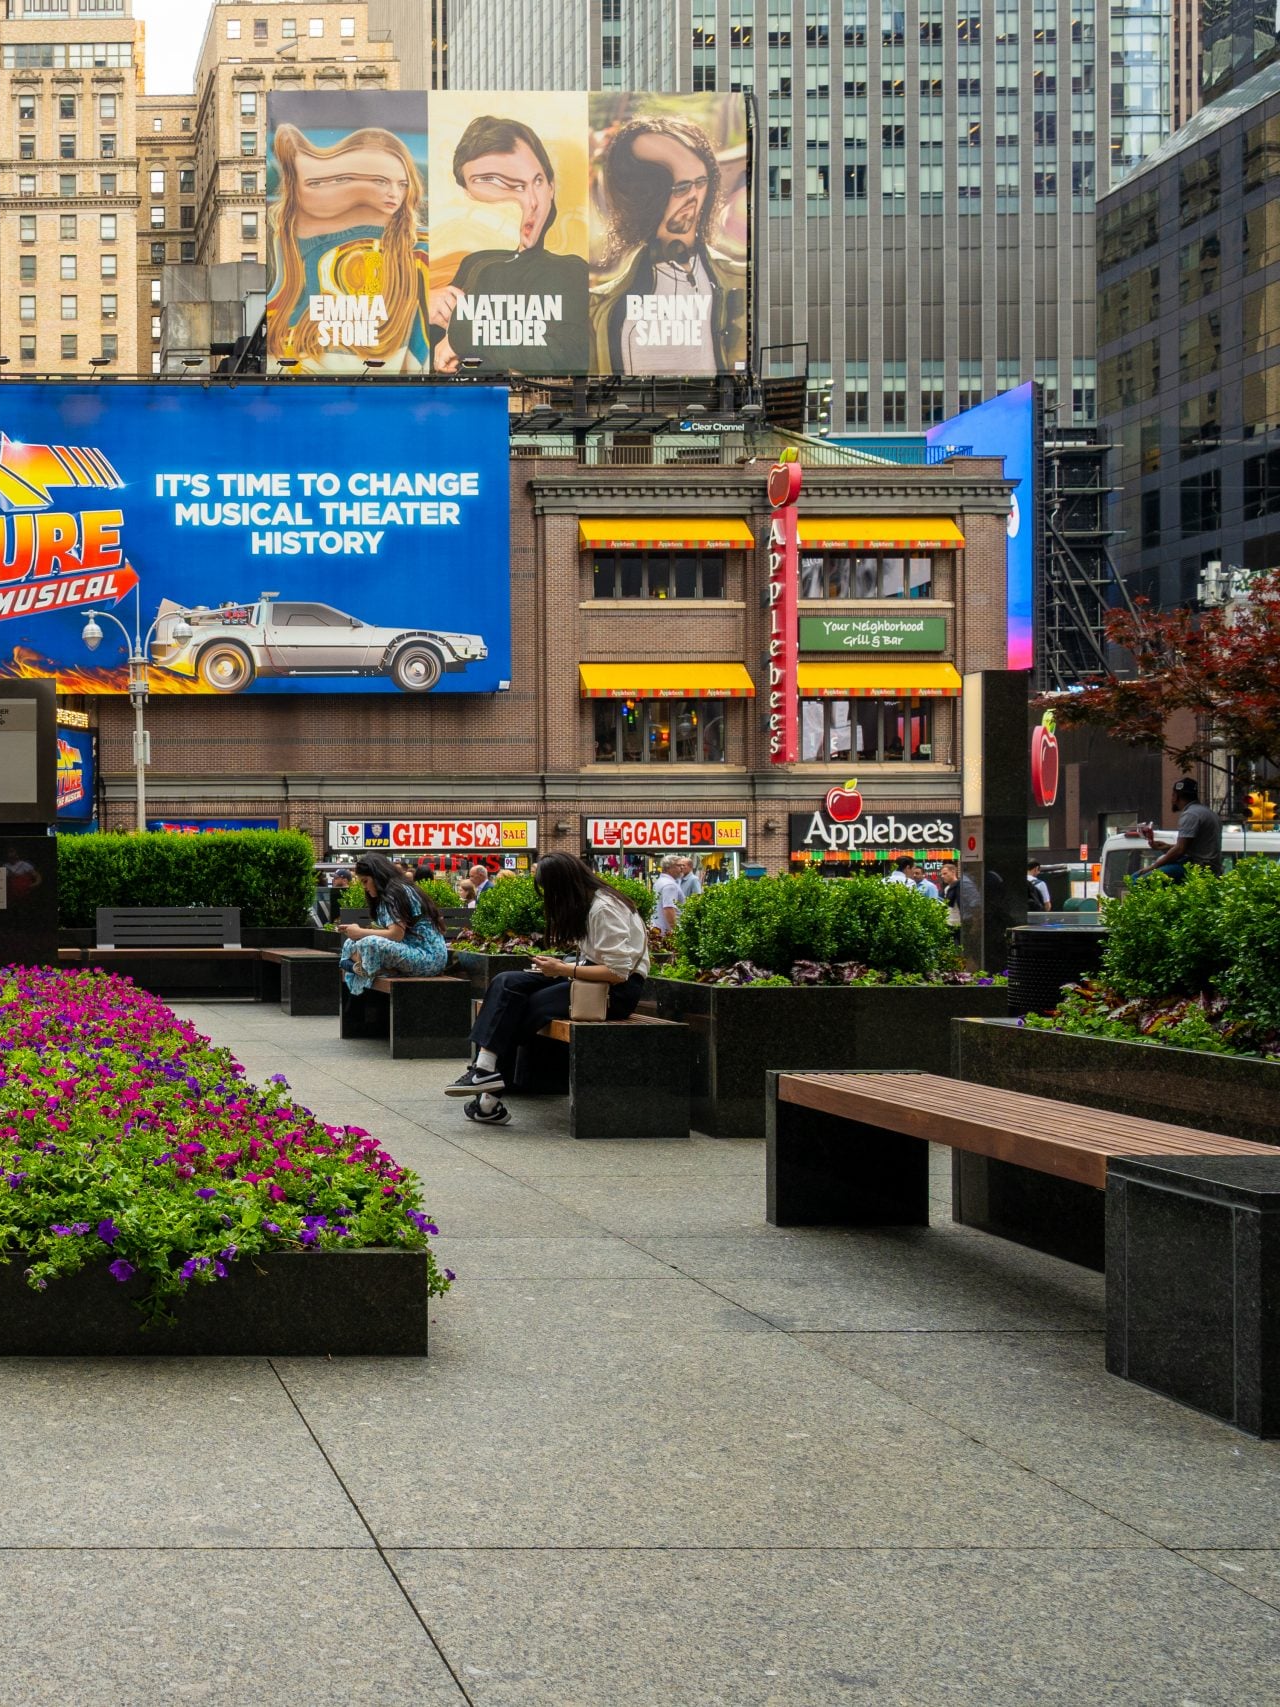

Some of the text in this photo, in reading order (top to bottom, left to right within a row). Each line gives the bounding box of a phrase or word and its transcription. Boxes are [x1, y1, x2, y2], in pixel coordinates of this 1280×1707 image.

[309, 295, 388, 321] EMMA
[457, 294, 562, 321] NATHAN
[627, 294, 711, 321] BENNY
[318, 321, 379, 347] STONE
[472, 321, 548, 347] FIELDER
[636, 321, 702, 347] SAFDIE
[691, 423, 745, 431] Clear Channel
[217, 473, 290, 497] TIME
[298, 472, 340, 497] TO
[348, 472, 479, 497] CHANGE
[175, 502, 460, 526] MUSICAL THEATER
[252, 531, 384, 554] HISTORY
[823, 620, 924, 636] Your Neighborhood
[843, 634, 904, 648] Grill & Bar
[56, 769, 83, 796] TURE
[340, 836, 360, 846] NY
[341, 825, 347, 836] I
[392, 822, 473, 847] GIFTS
[503, 829, 526, 839] SALE
[593, 821, 689, 846] LUGGAGE
[717, 828, 740, 838] SALE
[365, 839, 390, 847] NYPD
